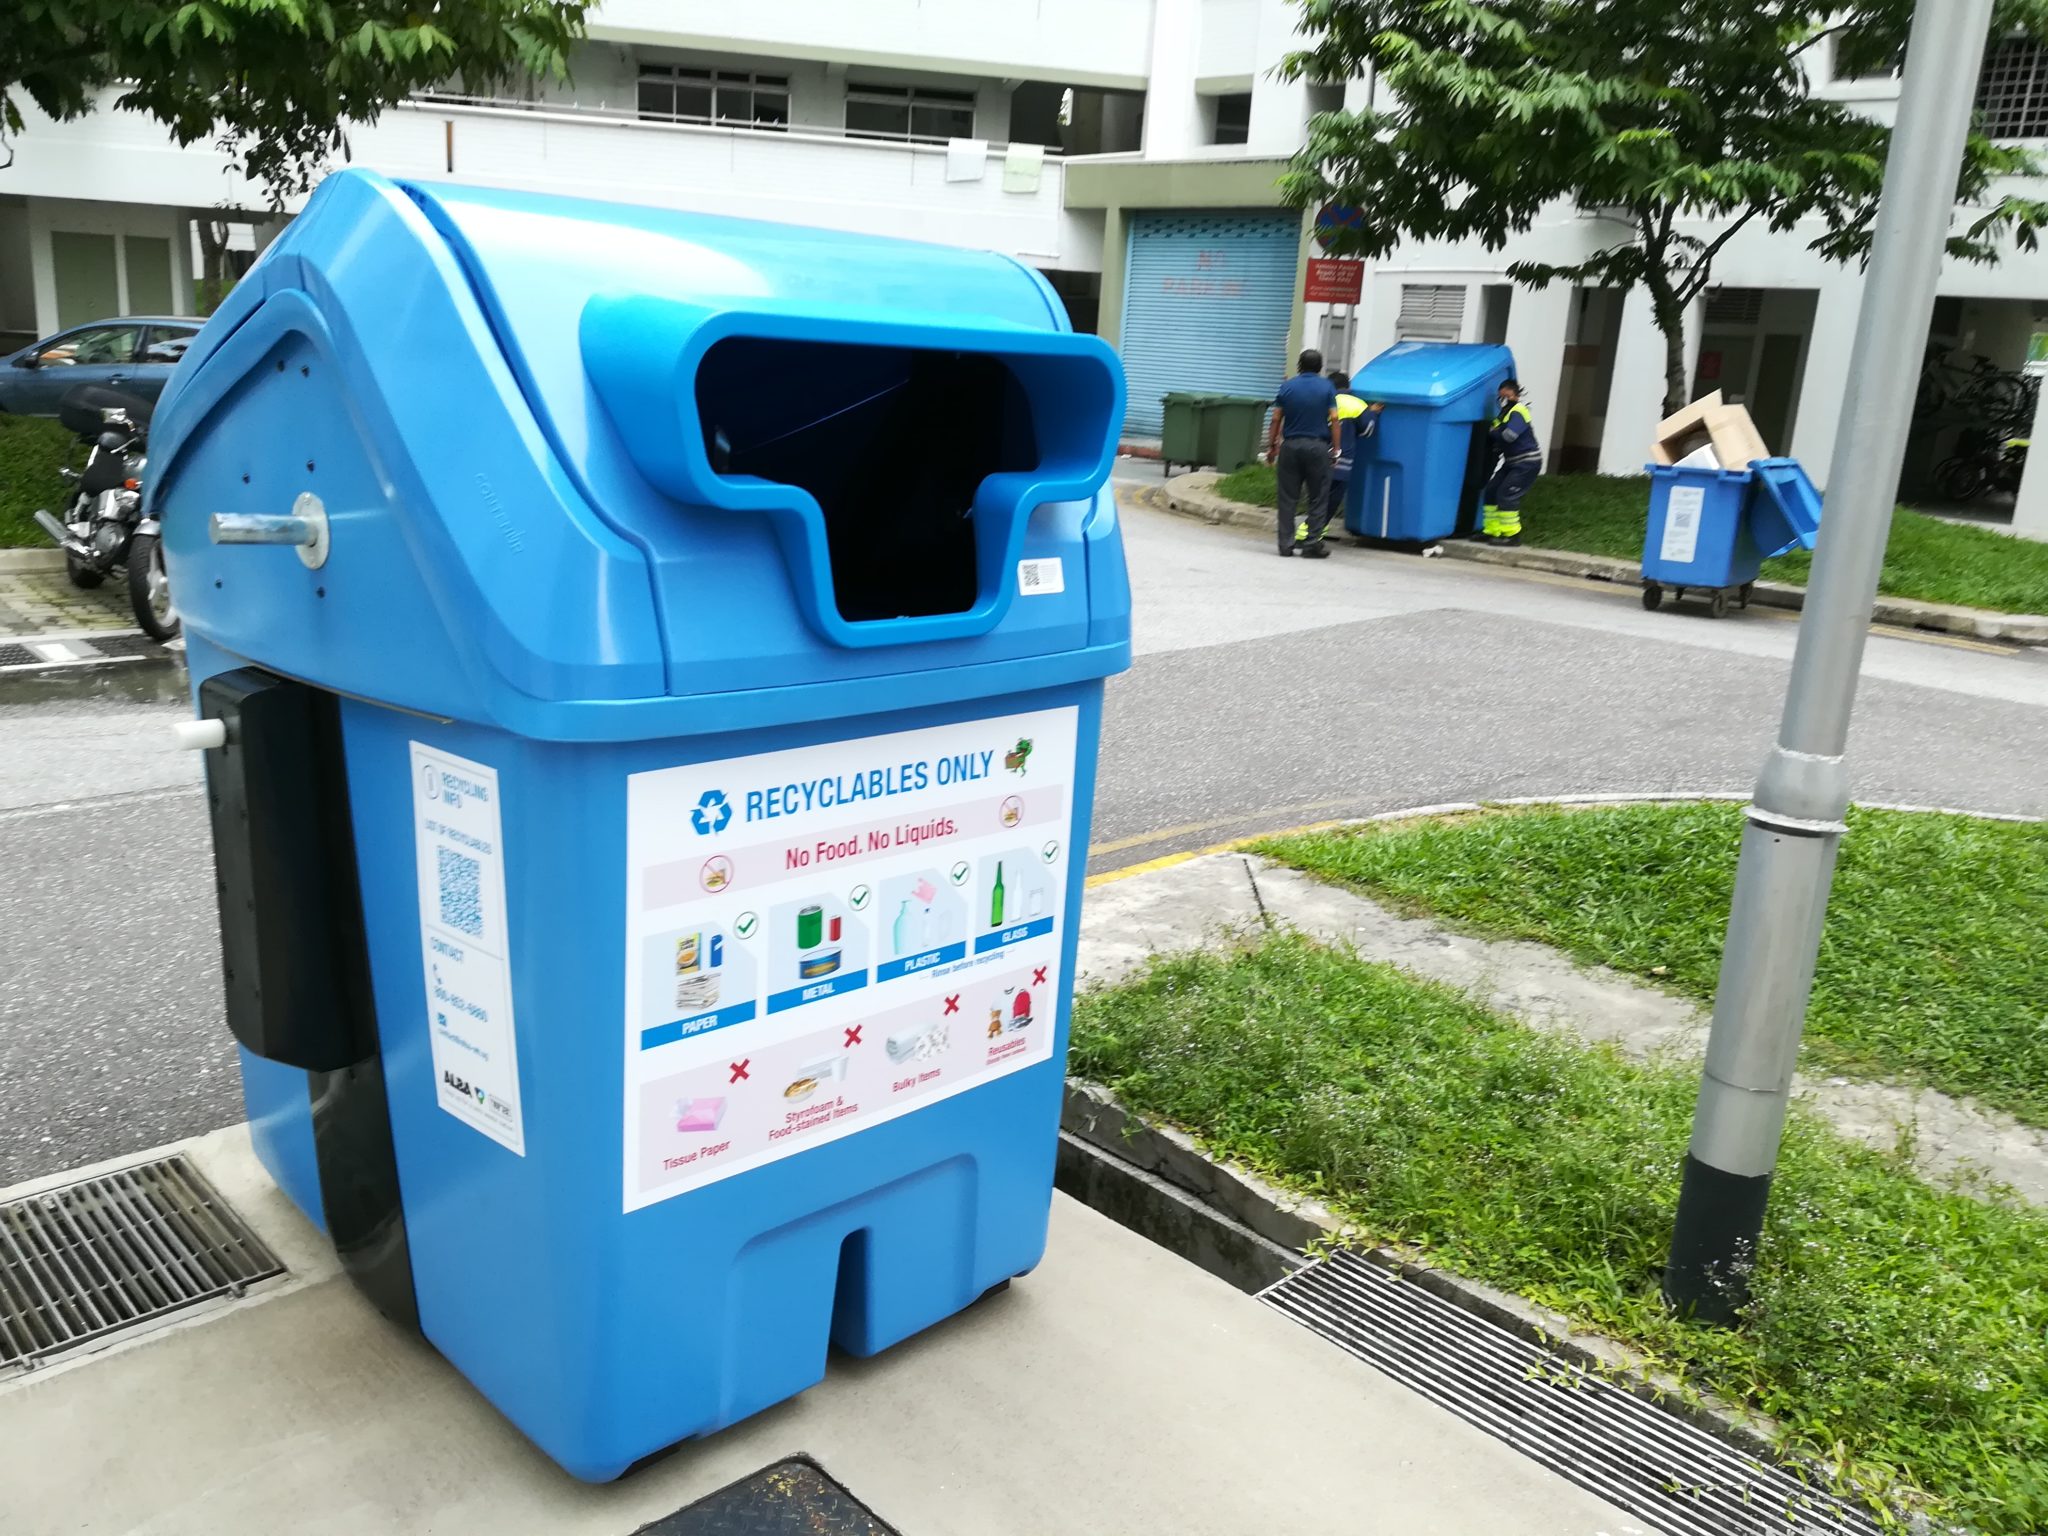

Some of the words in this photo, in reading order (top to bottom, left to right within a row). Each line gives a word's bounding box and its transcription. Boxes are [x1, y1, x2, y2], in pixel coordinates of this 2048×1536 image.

[746, 761, 928, 823] RECYCLABLES
[937, 750, 994, 785] ONLY
[786, 848, 809, 870] No
[816, 835, 863, 863] Food.
[867, 831, 889, 851] No
[896, 816, 959, 846] Liquids.
[1002, 927, 1028, 943] GLASS
[904, 951, 941, 972] PLASTIC
[802, 982, 836, 1001] METAL
[681, 1015, 718, 1035] PAPER
[892, 1075, 916, 1093] Bulky
[785, 1100, 834, 1124] Styrofoam
[836, 1096, 844, 1106] &
[768, 1113, 830, 1141] Food-stained
[663, 1150, 697, 1171] Tissue
[700, 1140, 731, 1159] Paper
